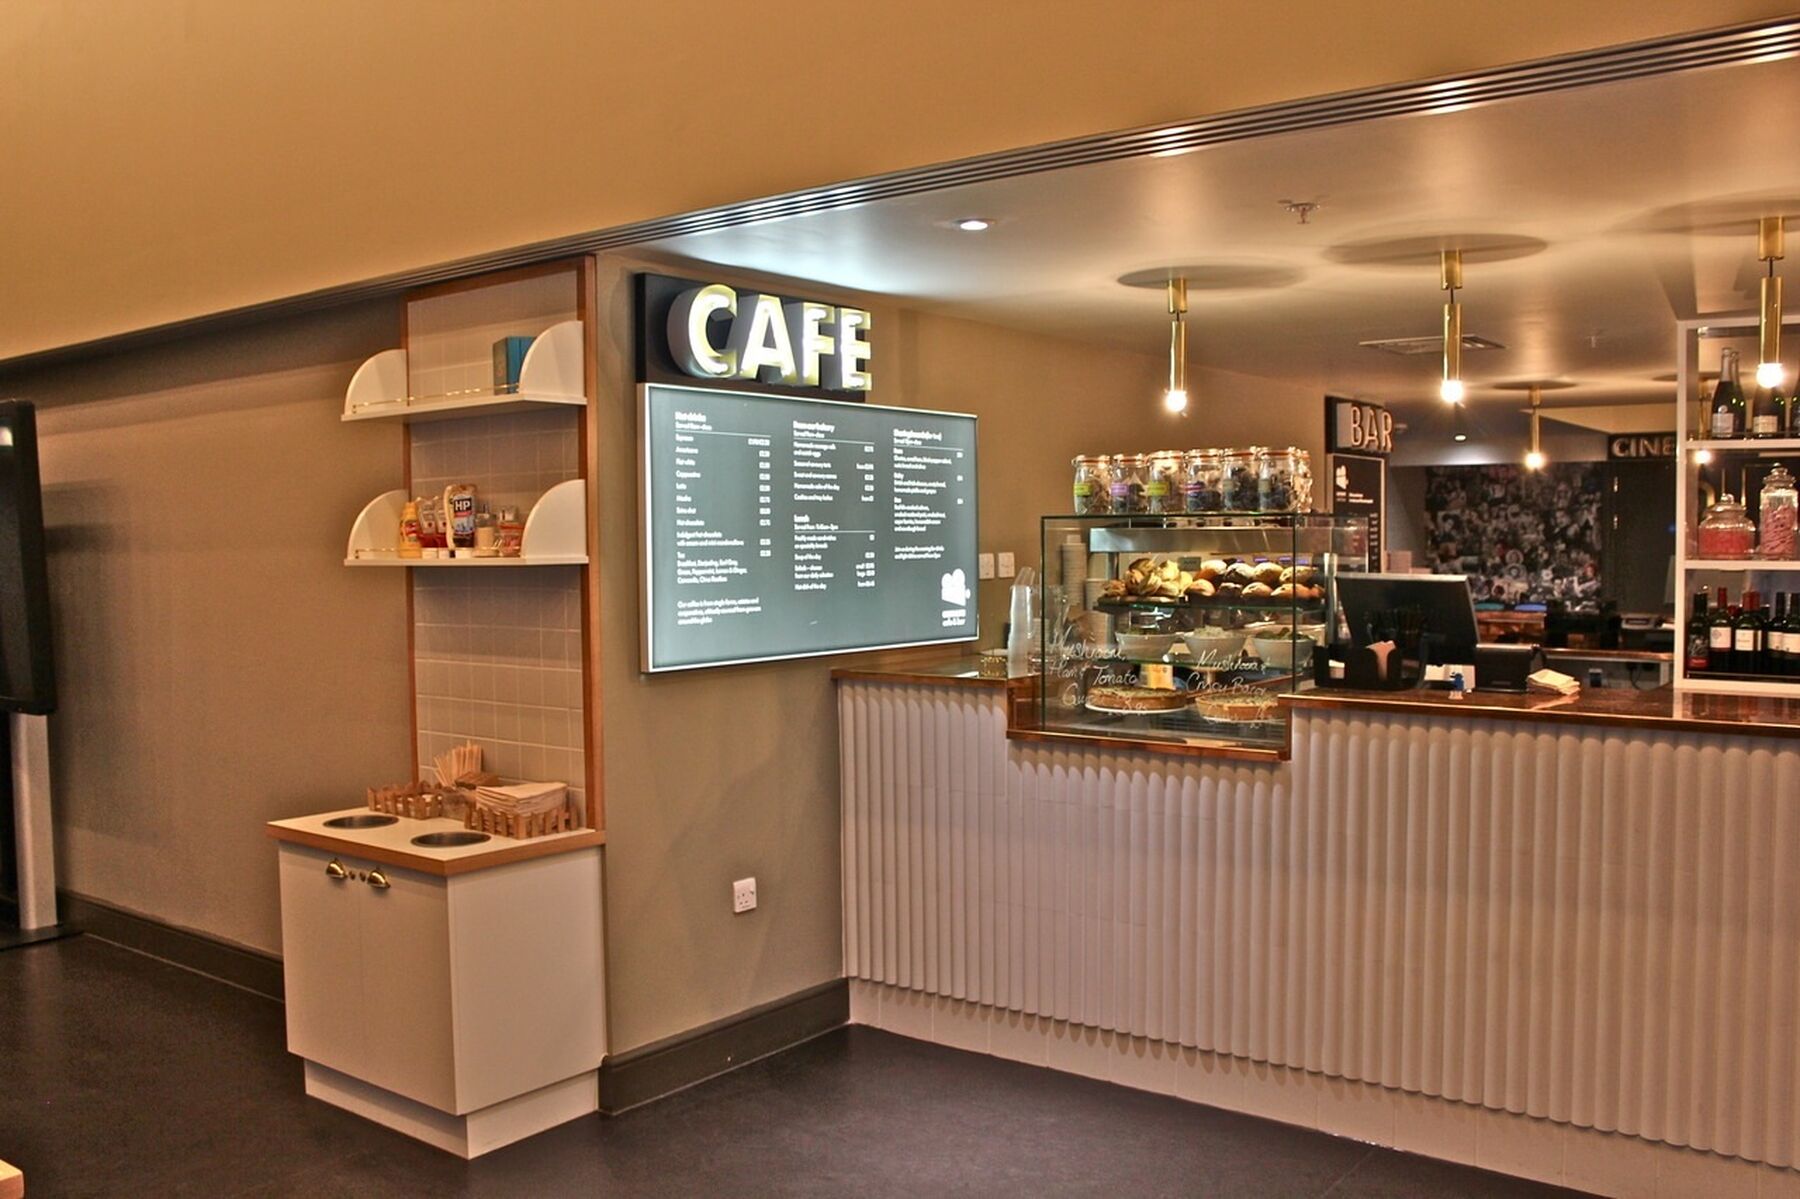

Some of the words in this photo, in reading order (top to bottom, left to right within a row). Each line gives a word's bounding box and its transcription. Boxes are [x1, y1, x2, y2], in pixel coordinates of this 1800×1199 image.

[682, 284, 873, 390] CAFE
[1350, 406, 1393, 452] BAR
[454, 499, 471, 511] HP
